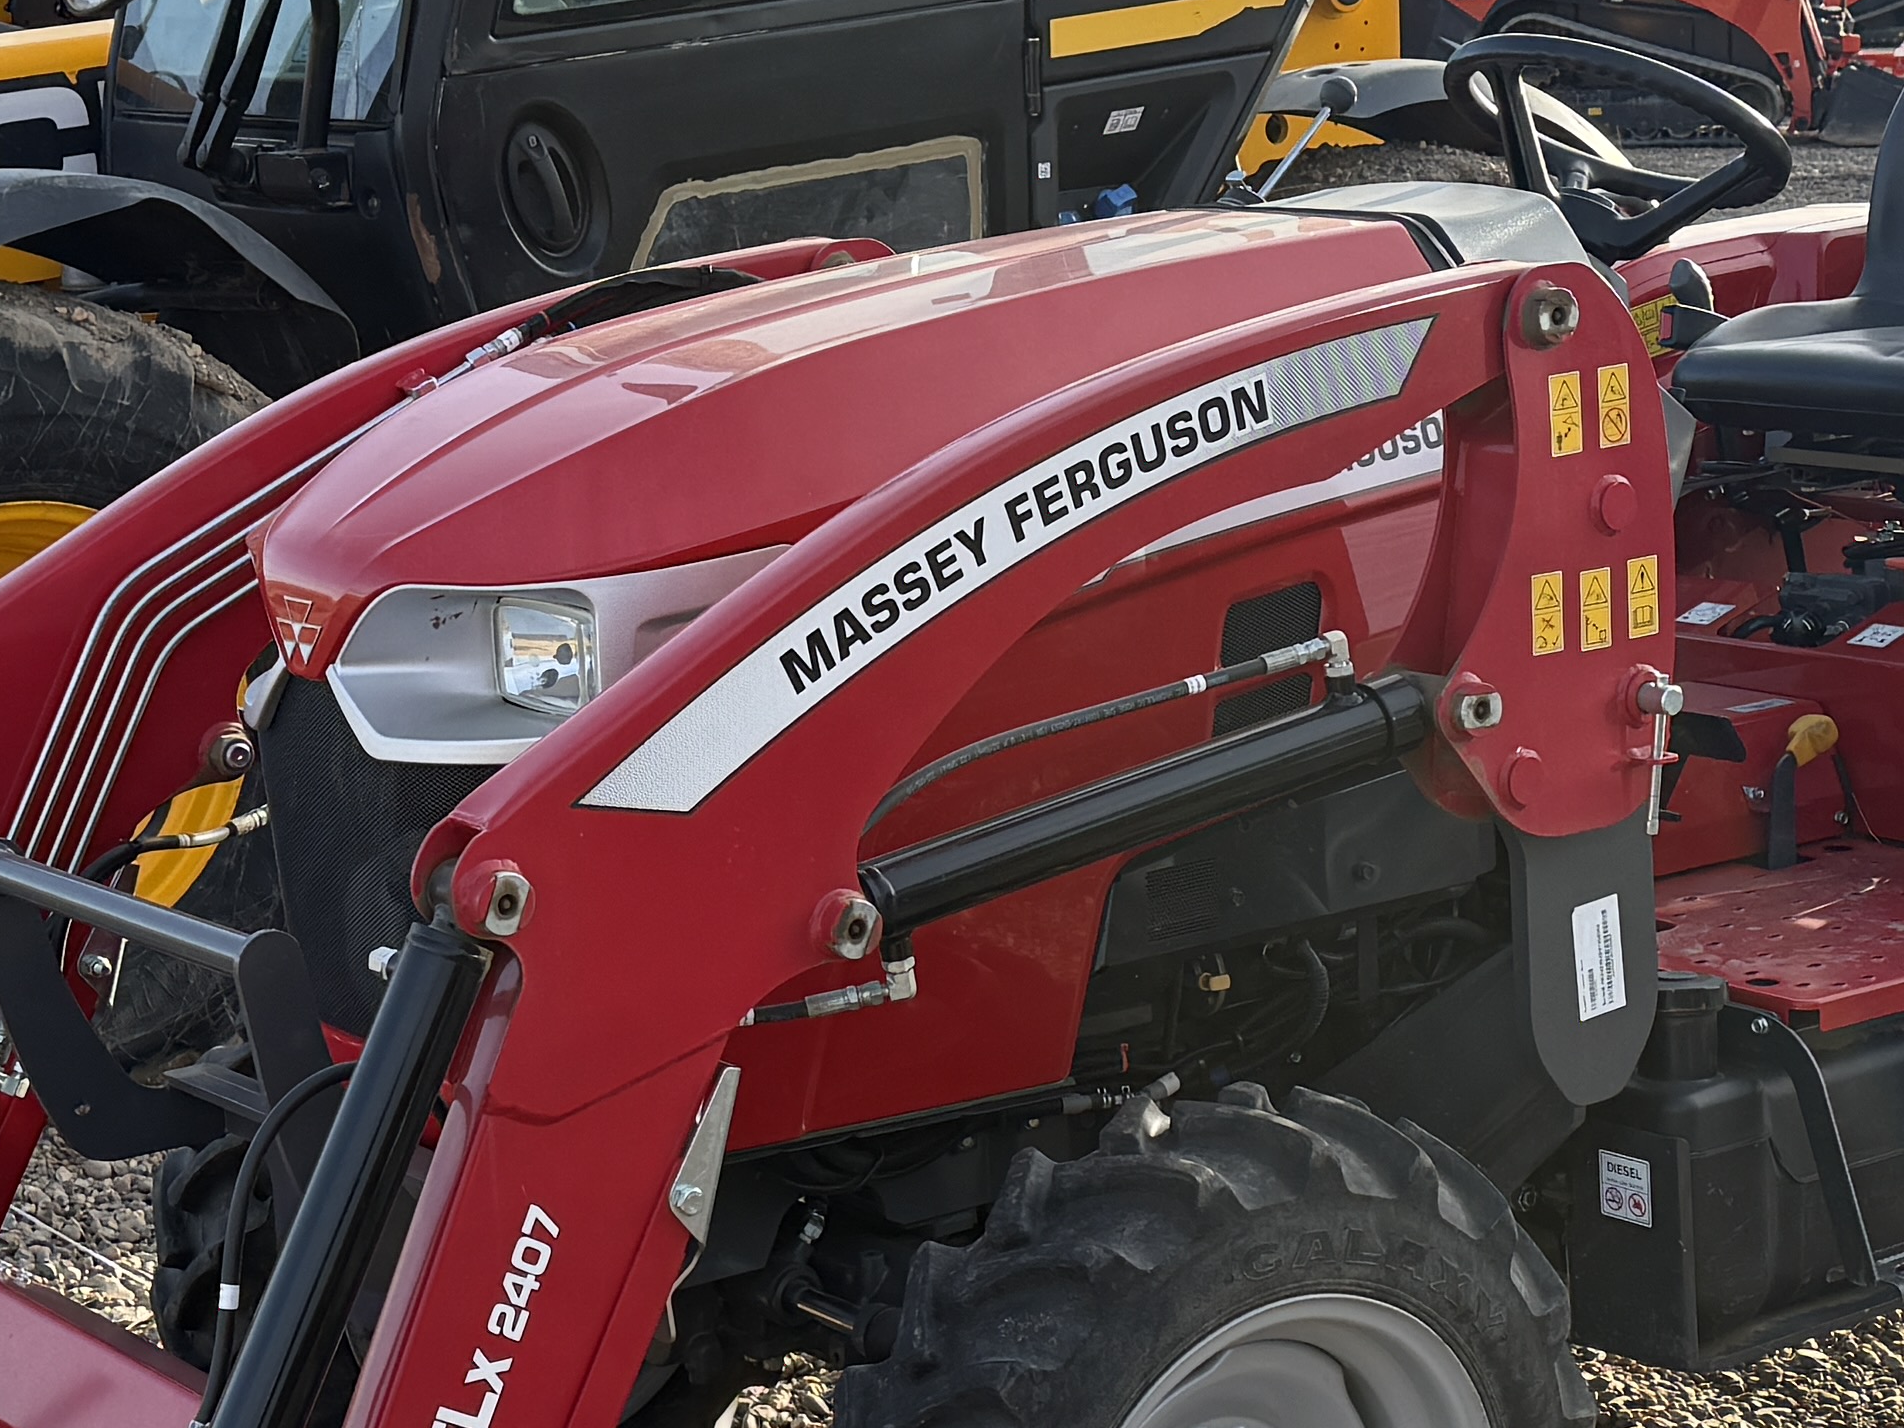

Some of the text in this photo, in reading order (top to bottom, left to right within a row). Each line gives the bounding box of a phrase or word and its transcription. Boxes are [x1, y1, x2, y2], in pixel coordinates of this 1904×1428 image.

[779, 379, 1270, 695] MASSEY FERGUSON
[1607, 1162, 1642, 1180] DIESEL
[487, 1203, 560, 1342] 2407
